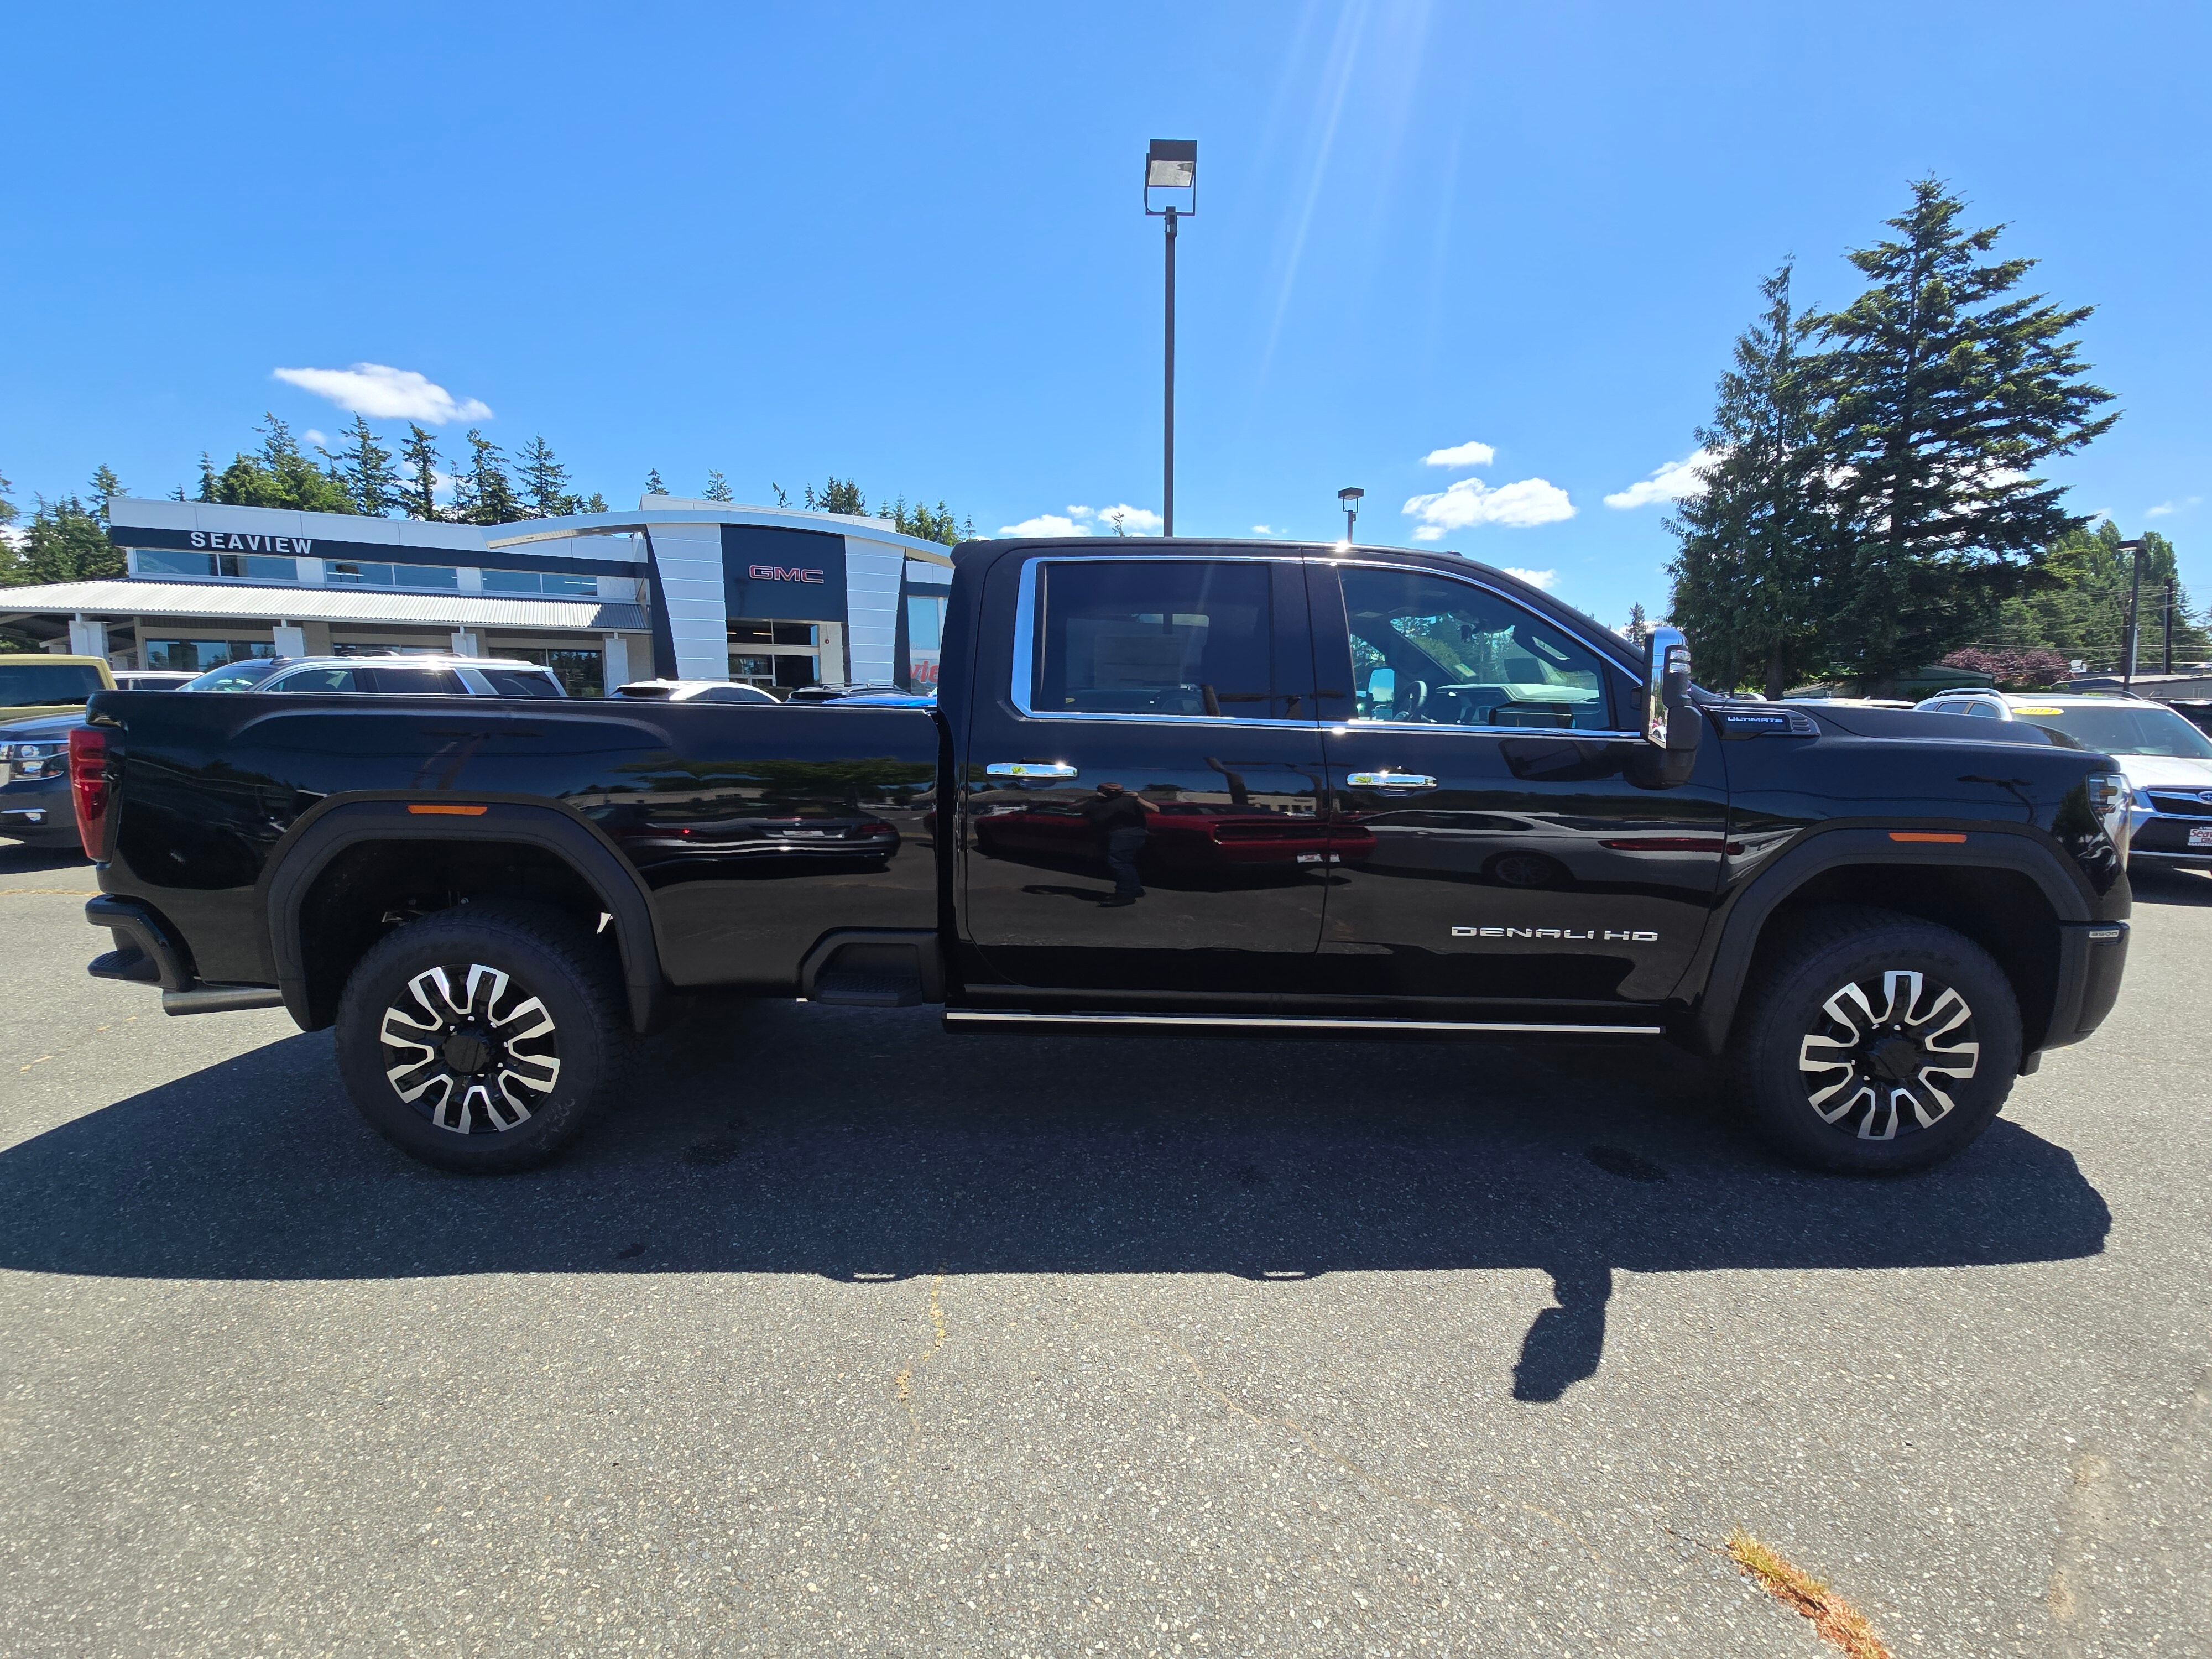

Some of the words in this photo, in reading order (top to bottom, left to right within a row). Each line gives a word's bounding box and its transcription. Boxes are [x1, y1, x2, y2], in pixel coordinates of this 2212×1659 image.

[190, 531, 312, 554] SEAVIEW
[749, 565, 824, 583] GMC
[1452, 926, 1594, 939] DENALI
[1604, 930, 1658, 941] HD
